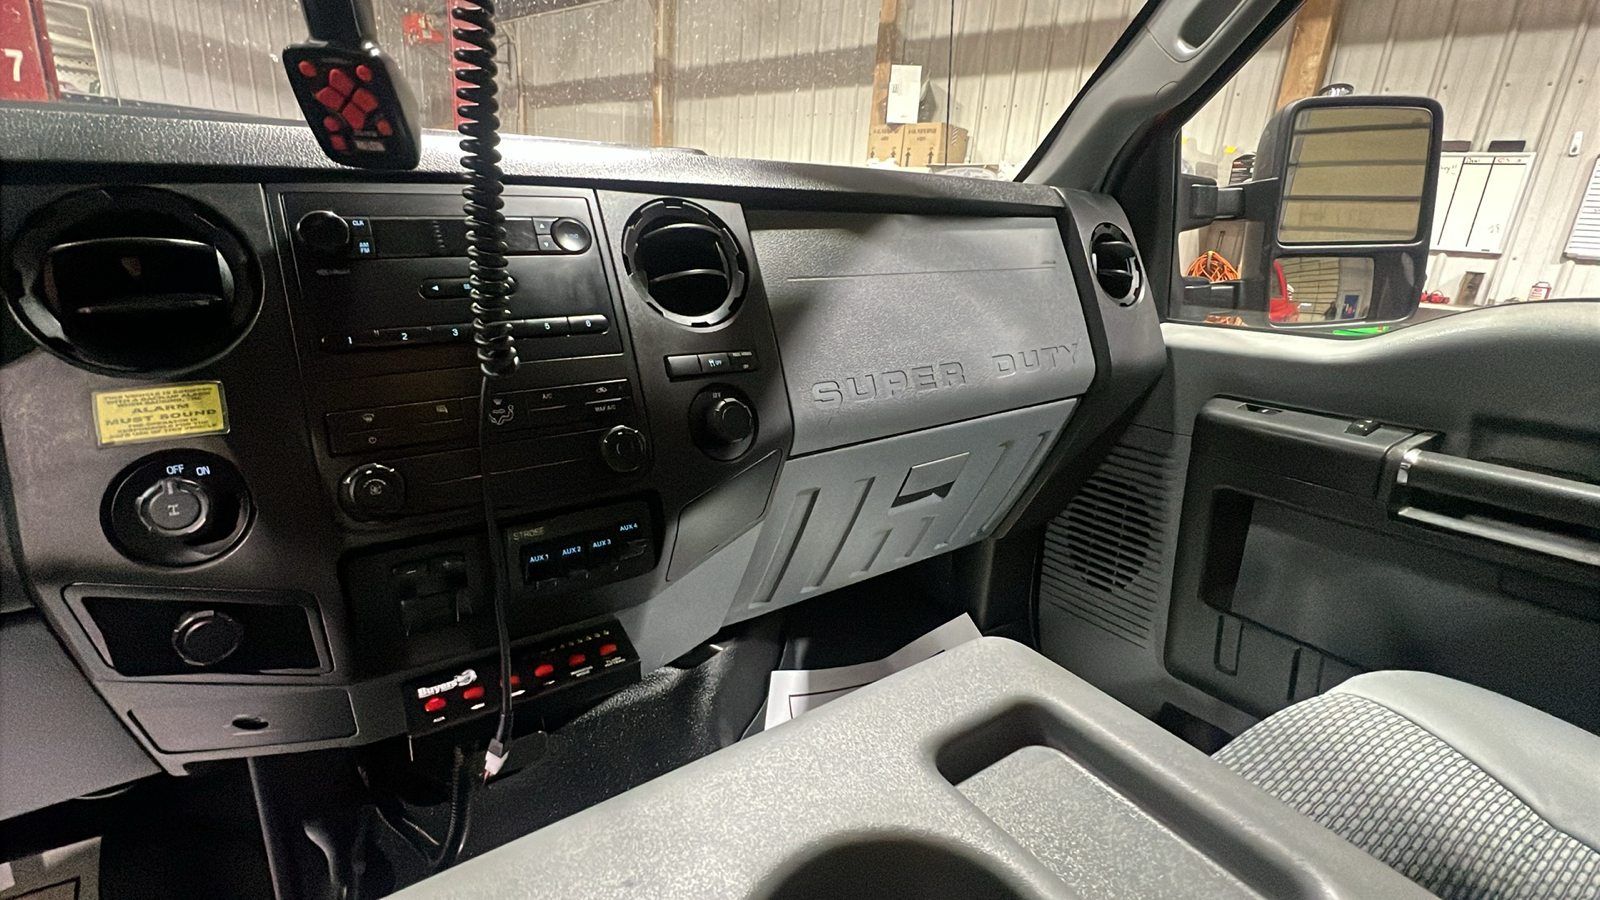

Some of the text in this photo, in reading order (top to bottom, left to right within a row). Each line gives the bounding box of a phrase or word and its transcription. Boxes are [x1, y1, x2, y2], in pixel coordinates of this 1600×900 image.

[4, 48, 24, 82] 7
[544, 322, 551, 330] 5
[585, 319, 592, 328] 6
[401, 332, 409, 342] 2
[451, 328, 459, 337] 3
[347, 336, 353, 345] 1
[812, 341, 1082, 408] SUPER DUTY
[124, 391, 161, 400] VEHICLE
[132, 403, 190, 414] ALARM
[105, 408, 217, 427] MUST SOUND
[166, 464, 210, 476] OFF ON
[620, 523, 633, 531] AUX
[592, 538, 611, 548] AUX 3
[562, 545, 581, 556] AUX 2
[530, 554, 545, 563] AUX
